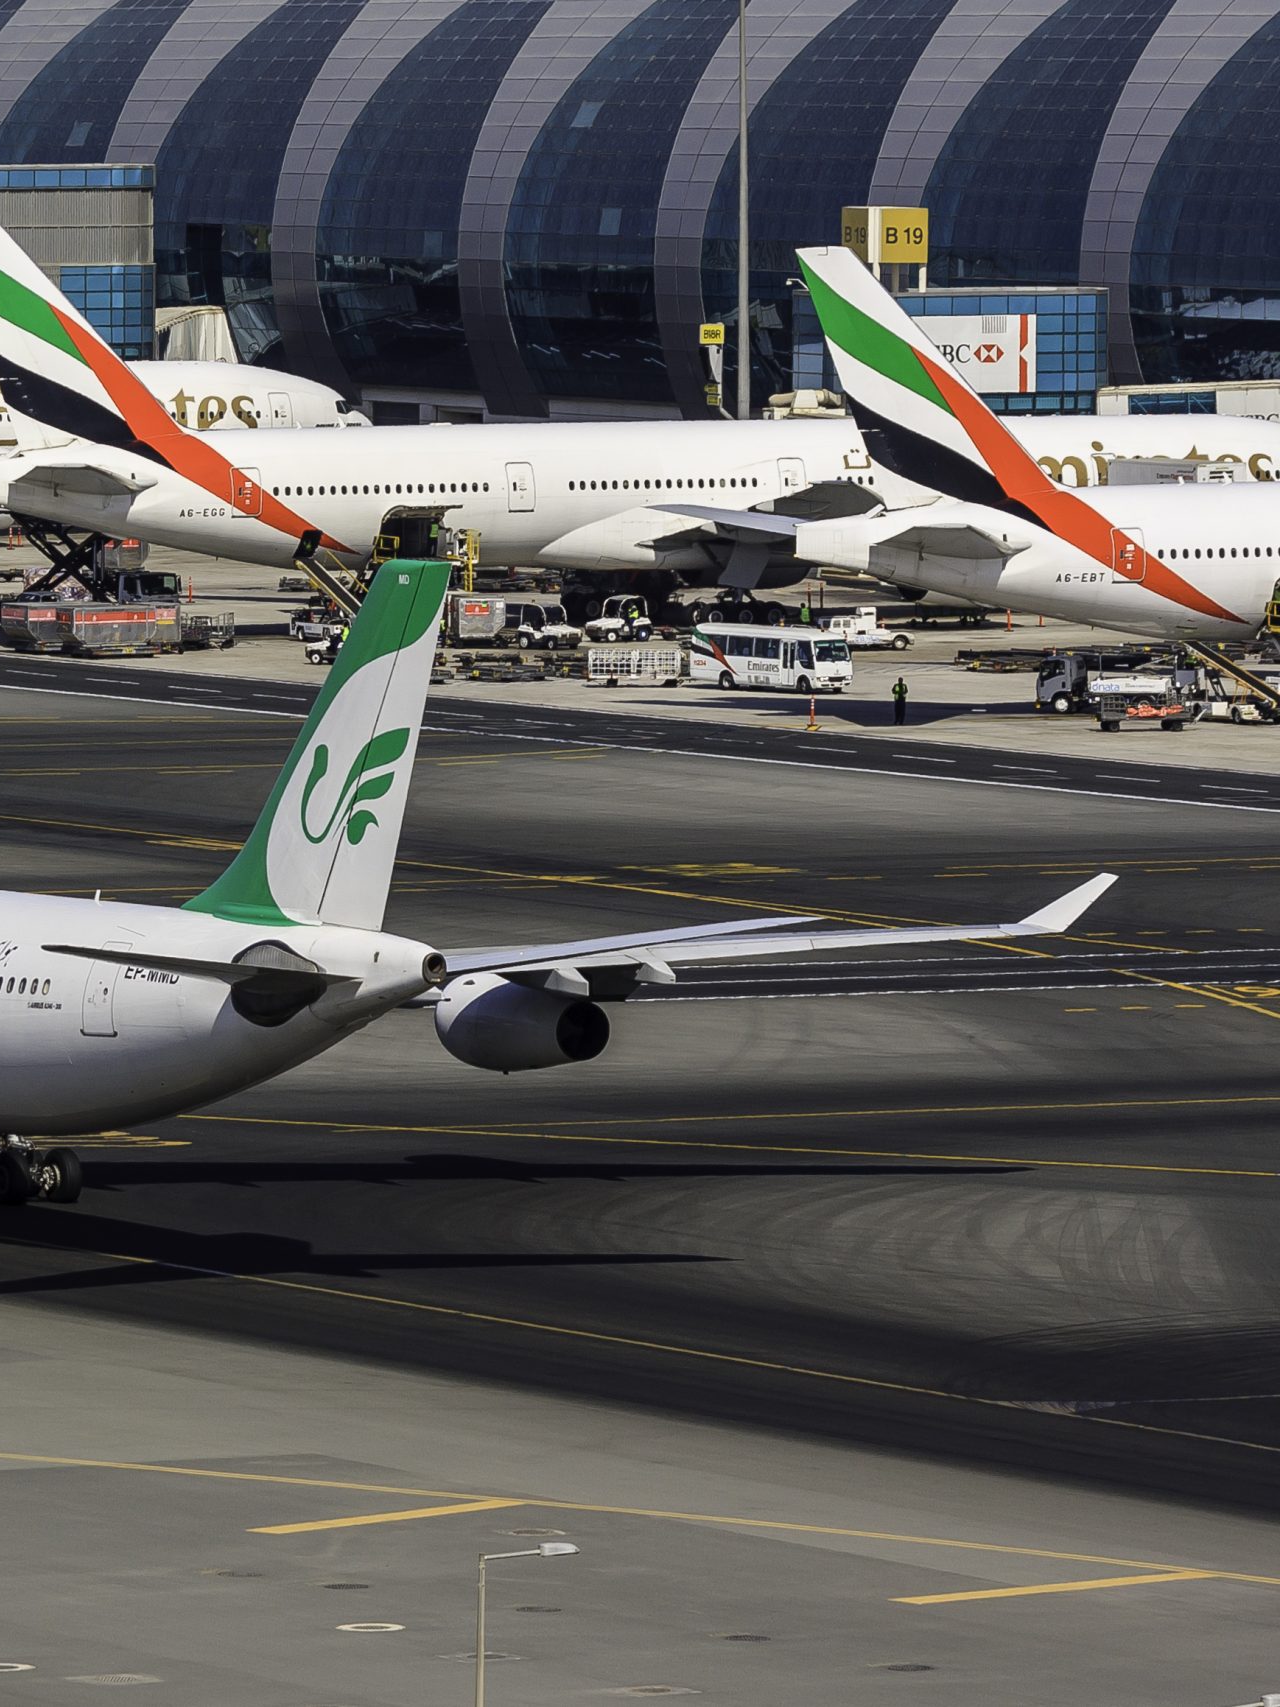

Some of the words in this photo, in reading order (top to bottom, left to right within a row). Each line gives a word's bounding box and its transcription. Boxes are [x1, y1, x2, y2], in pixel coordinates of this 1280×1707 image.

[844, 226, 852, 243] B
[855, 226, 867, 244] 19
[885, 227, 898, 244] B
[903, 227, 924, 245] 19
[934, 344, 970, 363] BC
[179, 508, 226, 518] A6-EGG
[398, 574, 410, 585] MD
[1055, 572, 1105, 583] A6-EBT
[747, 660, 780, 672] Emirates
[1092, 682, 1120, 692] dnata
